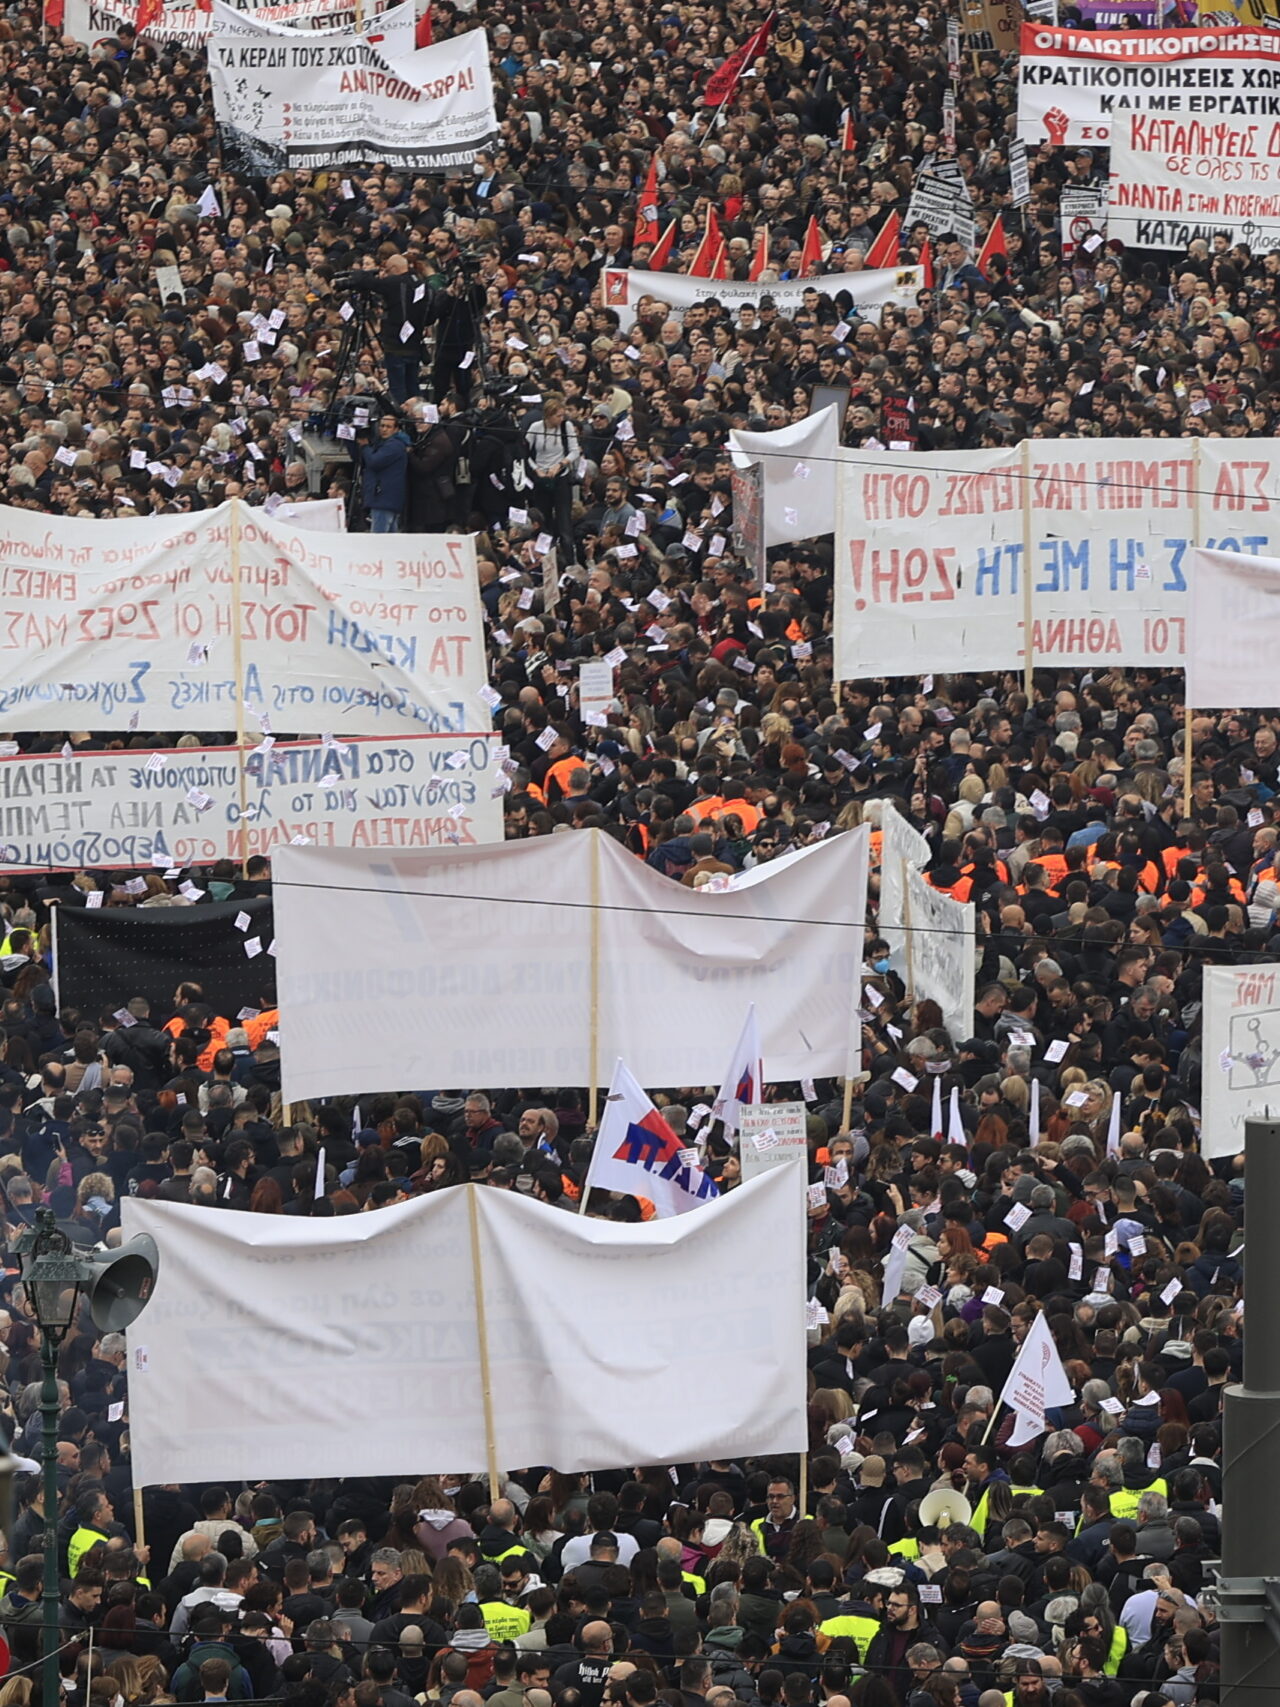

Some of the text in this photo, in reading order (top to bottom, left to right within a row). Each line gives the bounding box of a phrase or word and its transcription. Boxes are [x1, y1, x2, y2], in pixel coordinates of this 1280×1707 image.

[1035, 32, 1062, 49] ΟΙ
[218, 45, 397, 74] ΤΑ ΚΕΡΔΗ ΤΟΥΣ ΣΚΟΤΩΝΟ
[1023, 65, 1234, 88] ΚΡΑΤΙΚΟΠΟΙΗΣΕΙΣ
[1150, 95, 1180, 111] ΜΕ
[1131, 114, 1259, 157] ΚΑΤΑΛΗΨΕΙΣ
